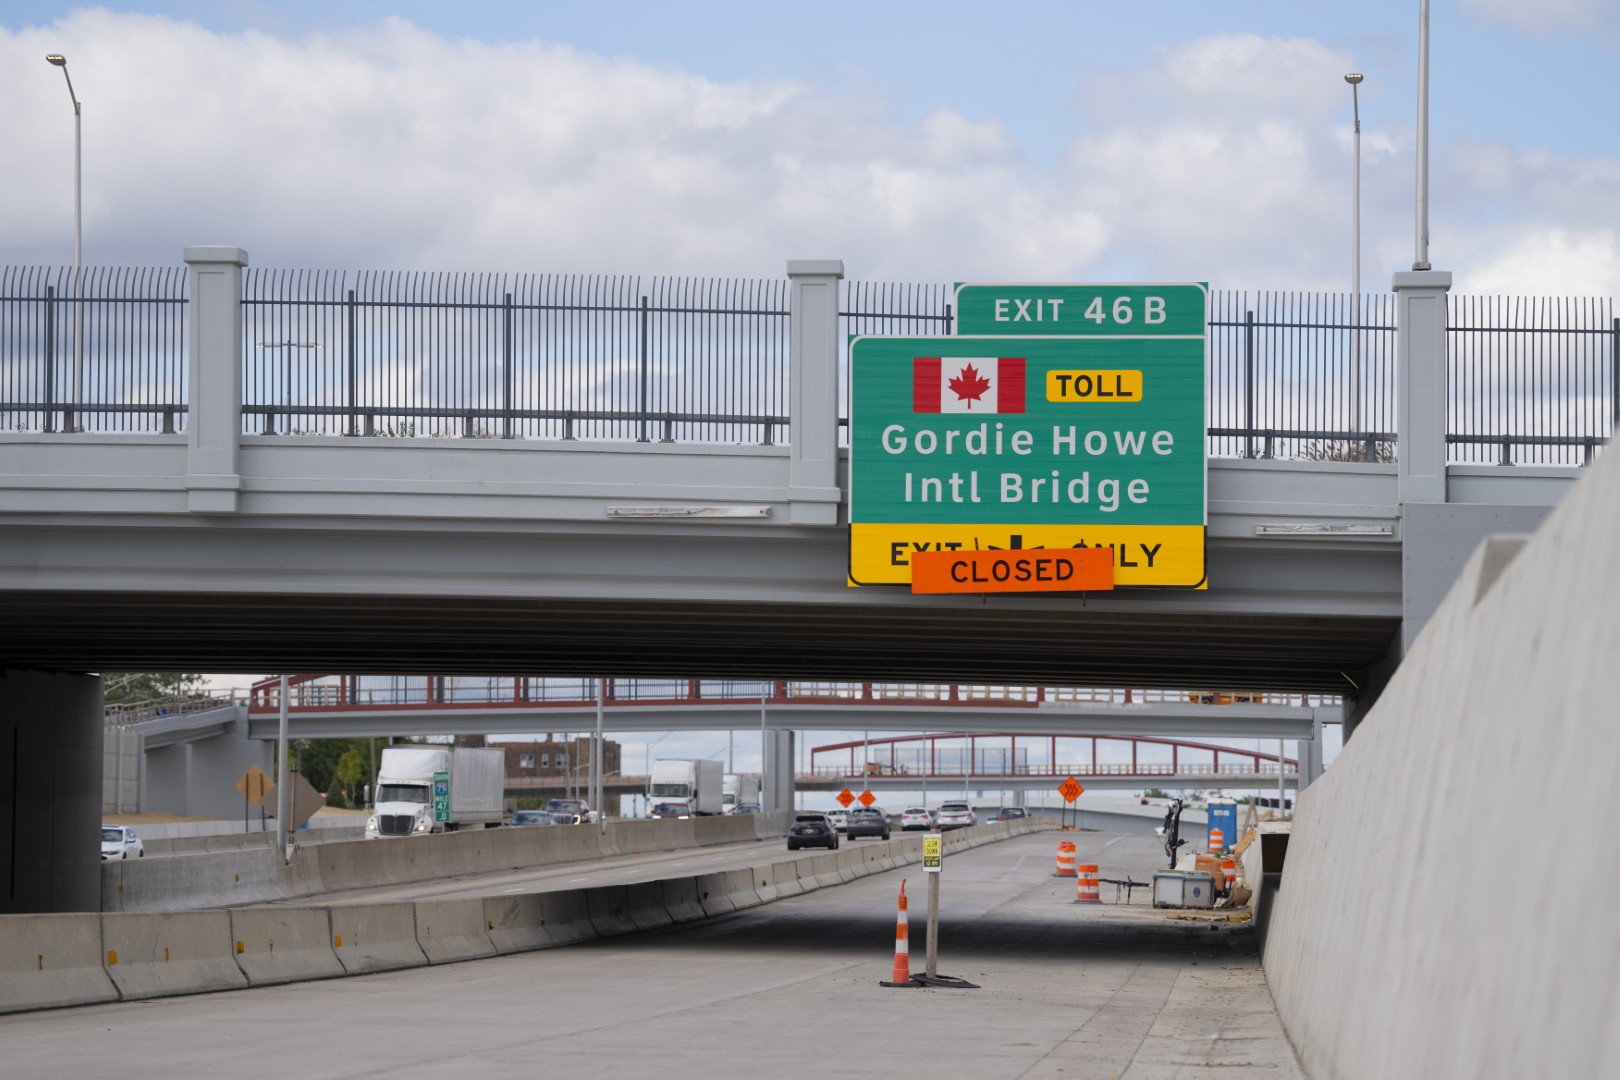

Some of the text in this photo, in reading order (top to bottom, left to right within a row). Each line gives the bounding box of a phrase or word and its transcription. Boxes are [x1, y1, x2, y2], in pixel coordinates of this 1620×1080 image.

[994, 298, 1064, 322] EXIT
[1055, 374, 1134, 397] TOLL
[881, 423, 1175, 456] Gordie Howe
[904, 470, 1150, 513] Intl Bridge
[1072, 543, 1163, 568] LY
[950, 558, 1074, 583] CLOSED
[437, 802, 447, 810] 47
